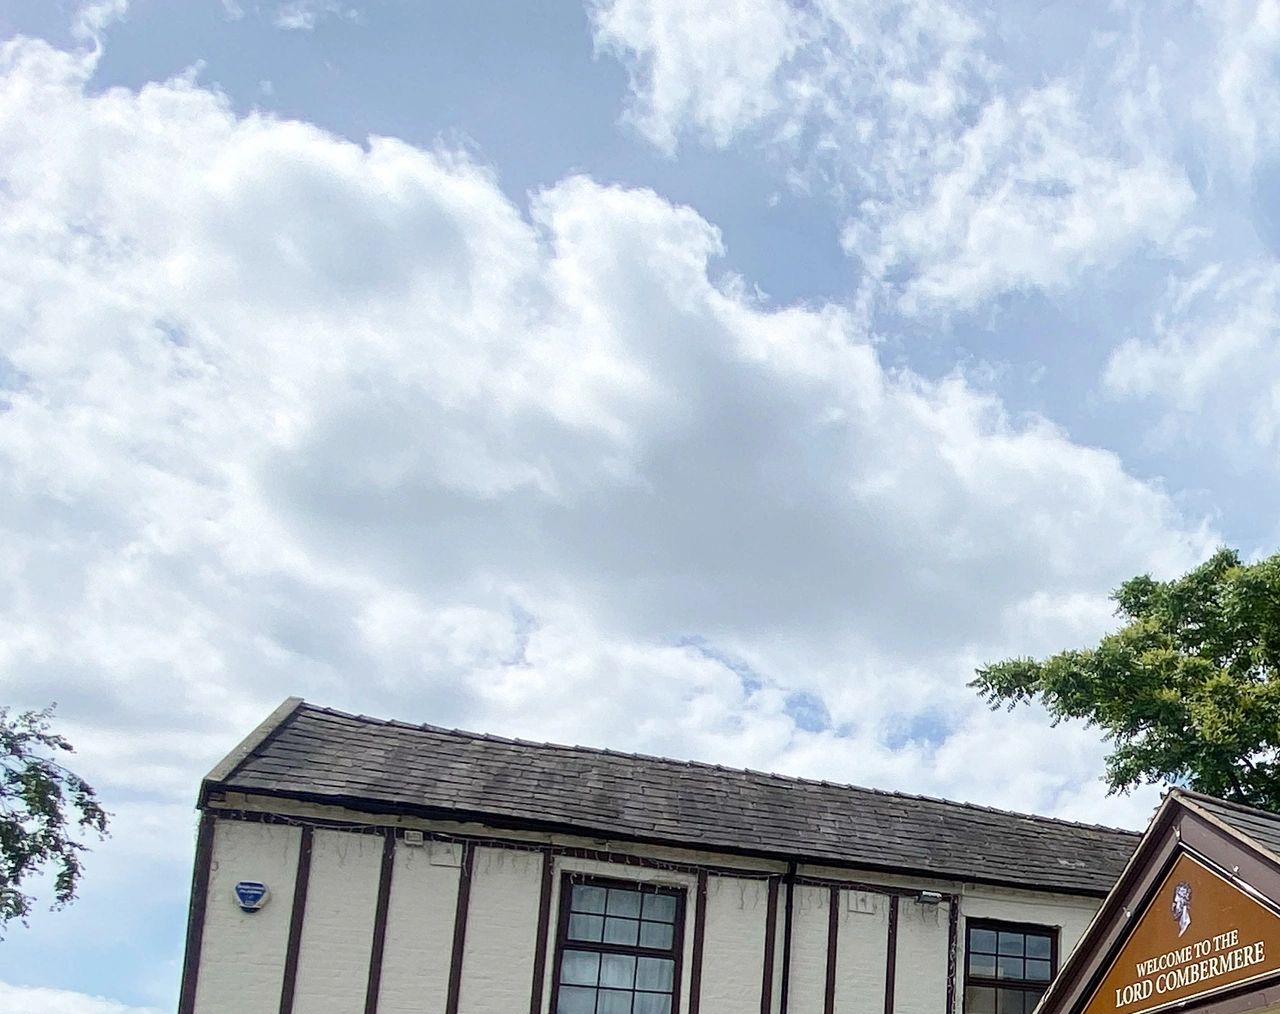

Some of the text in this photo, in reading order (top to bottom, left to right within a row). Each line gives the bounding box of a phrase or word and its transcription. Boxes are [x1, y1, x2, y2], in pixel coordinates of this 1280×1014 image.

[1115, 941, 1265, 1008] LORD COMBERMERE
[1136, 929, 1239, 978] WELCOME TO THE
